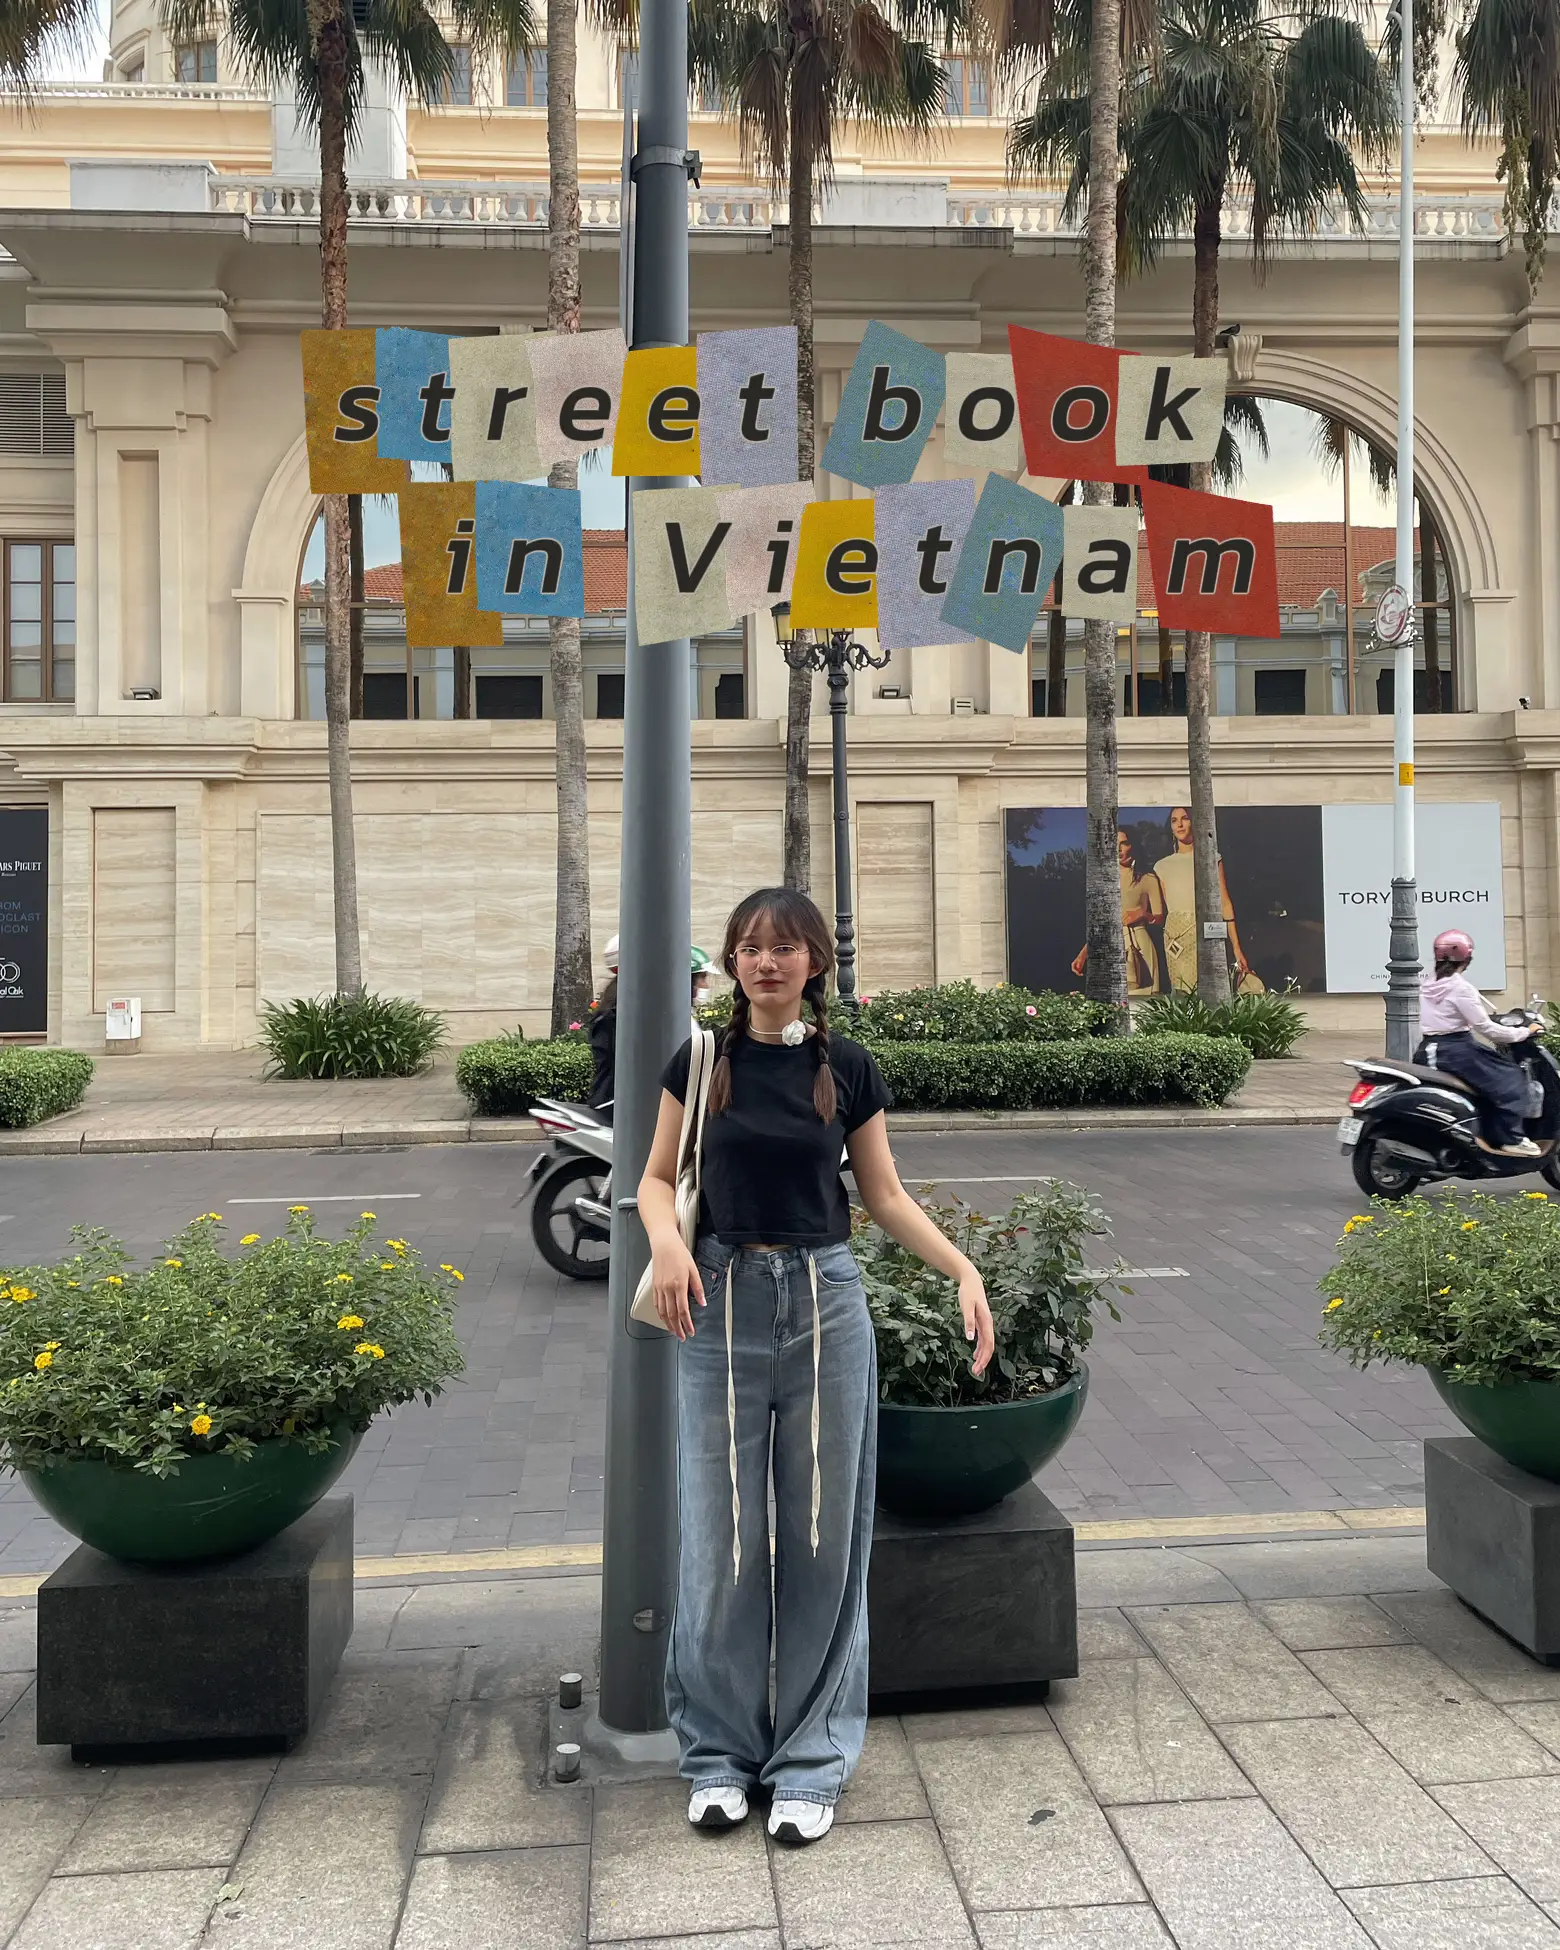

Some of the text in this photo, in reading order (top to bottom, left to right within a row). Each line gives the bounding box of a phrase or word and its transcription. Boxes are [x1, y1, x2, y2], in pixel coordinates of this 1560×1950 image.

[14, 860, 42, 871] PIGUET
[1338, 890, 1490, 905] TORY BURCH
